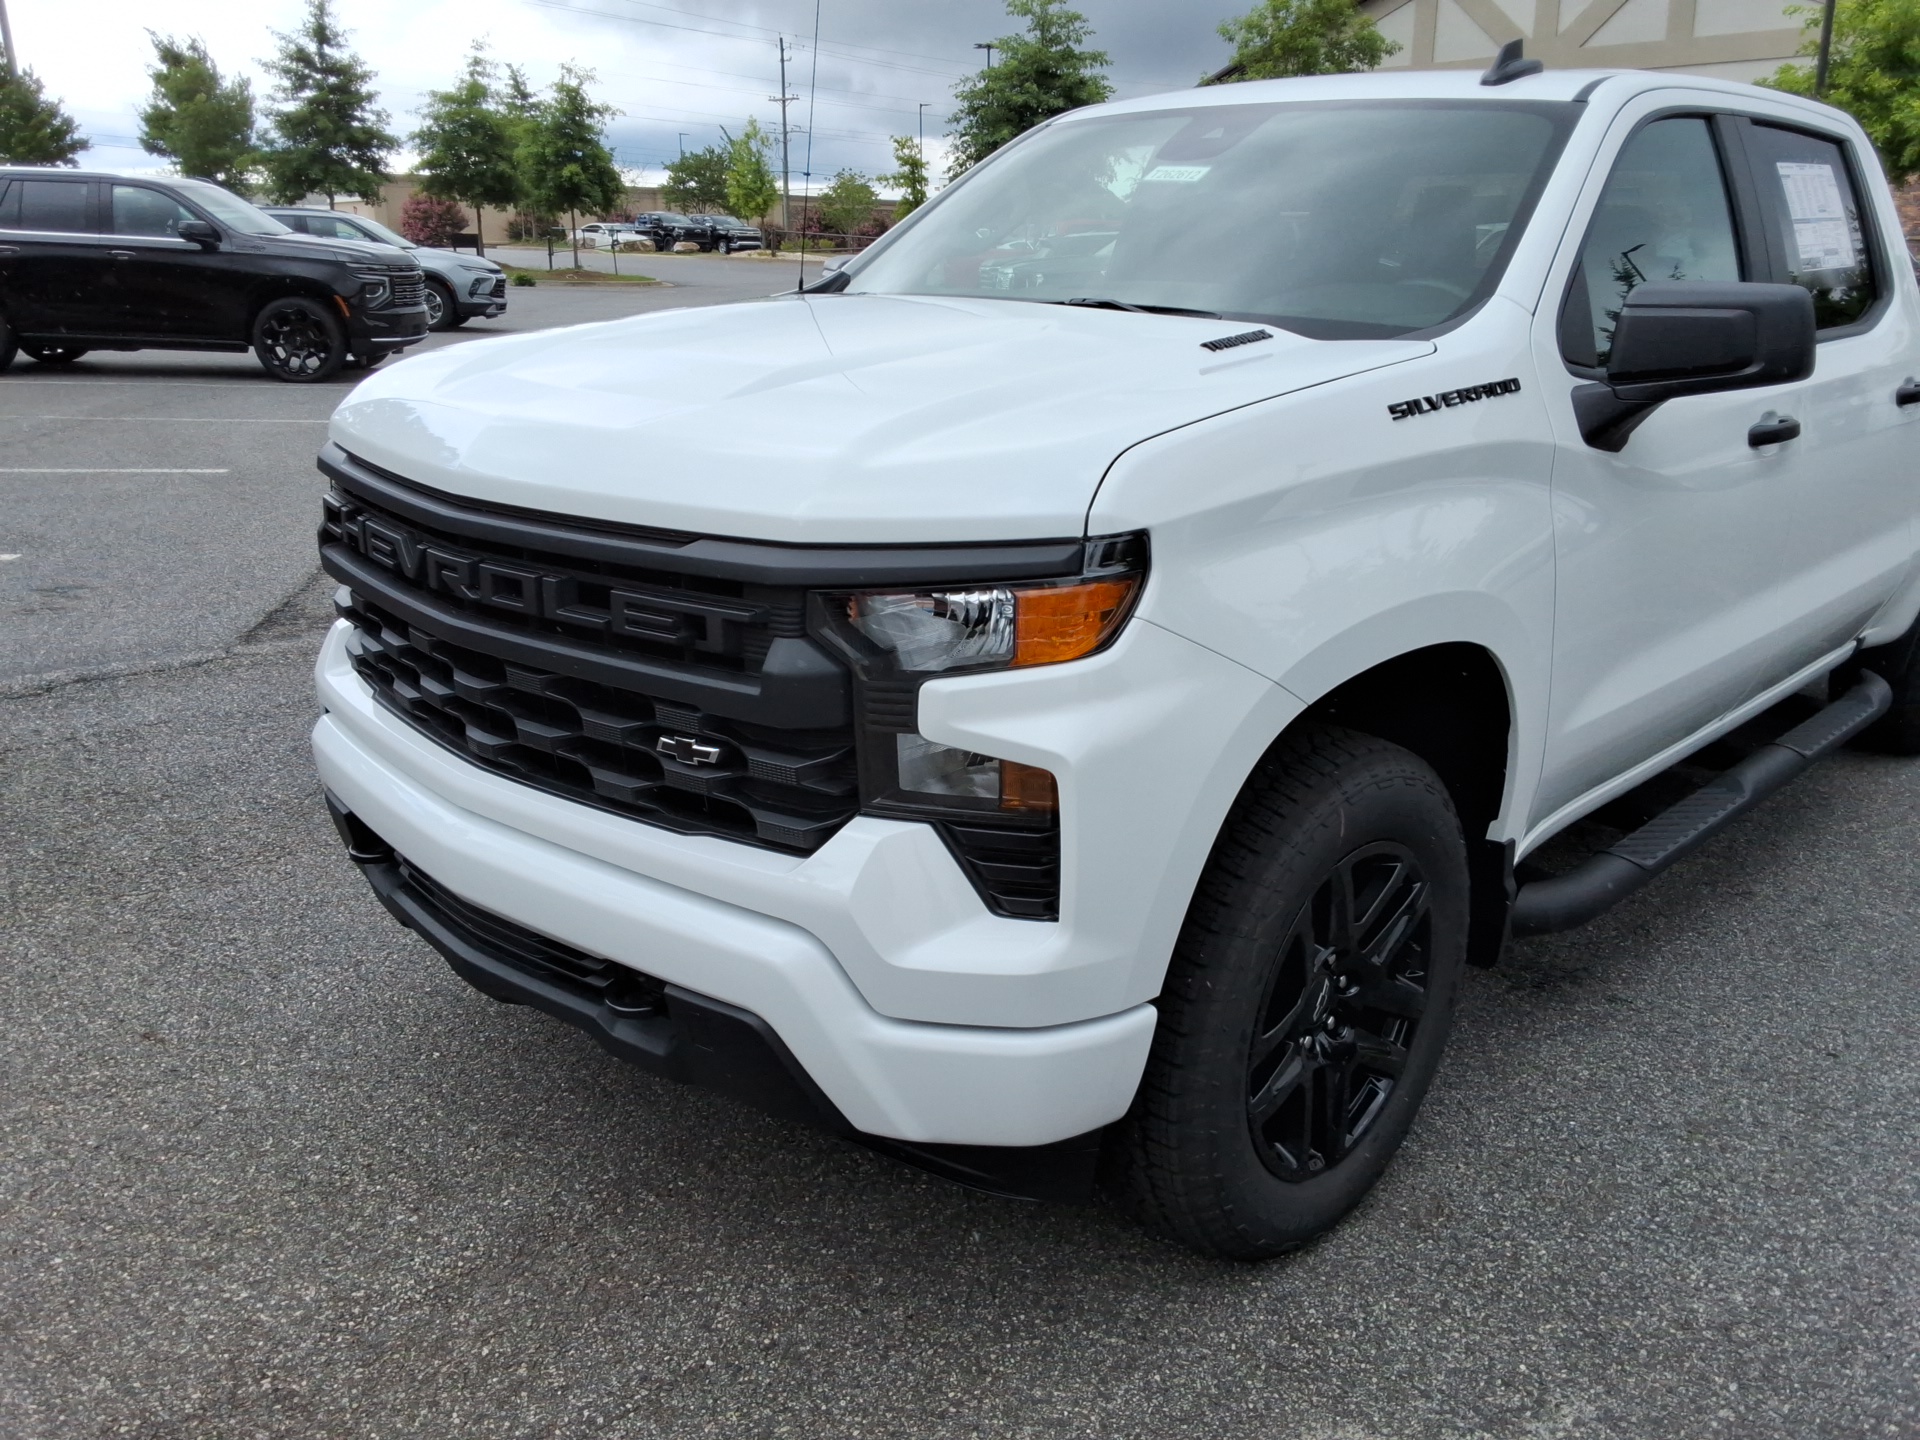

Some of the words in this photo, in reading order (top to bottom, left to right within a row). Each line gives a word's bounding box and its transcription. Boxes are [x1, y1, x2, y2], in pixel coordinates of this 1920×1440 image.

[1200, 328, 1274, 352] TURBOMAX
[1387, 377, 1521, 421] SILVERADO
[322, 493, 770, 653] CHEVROLET
